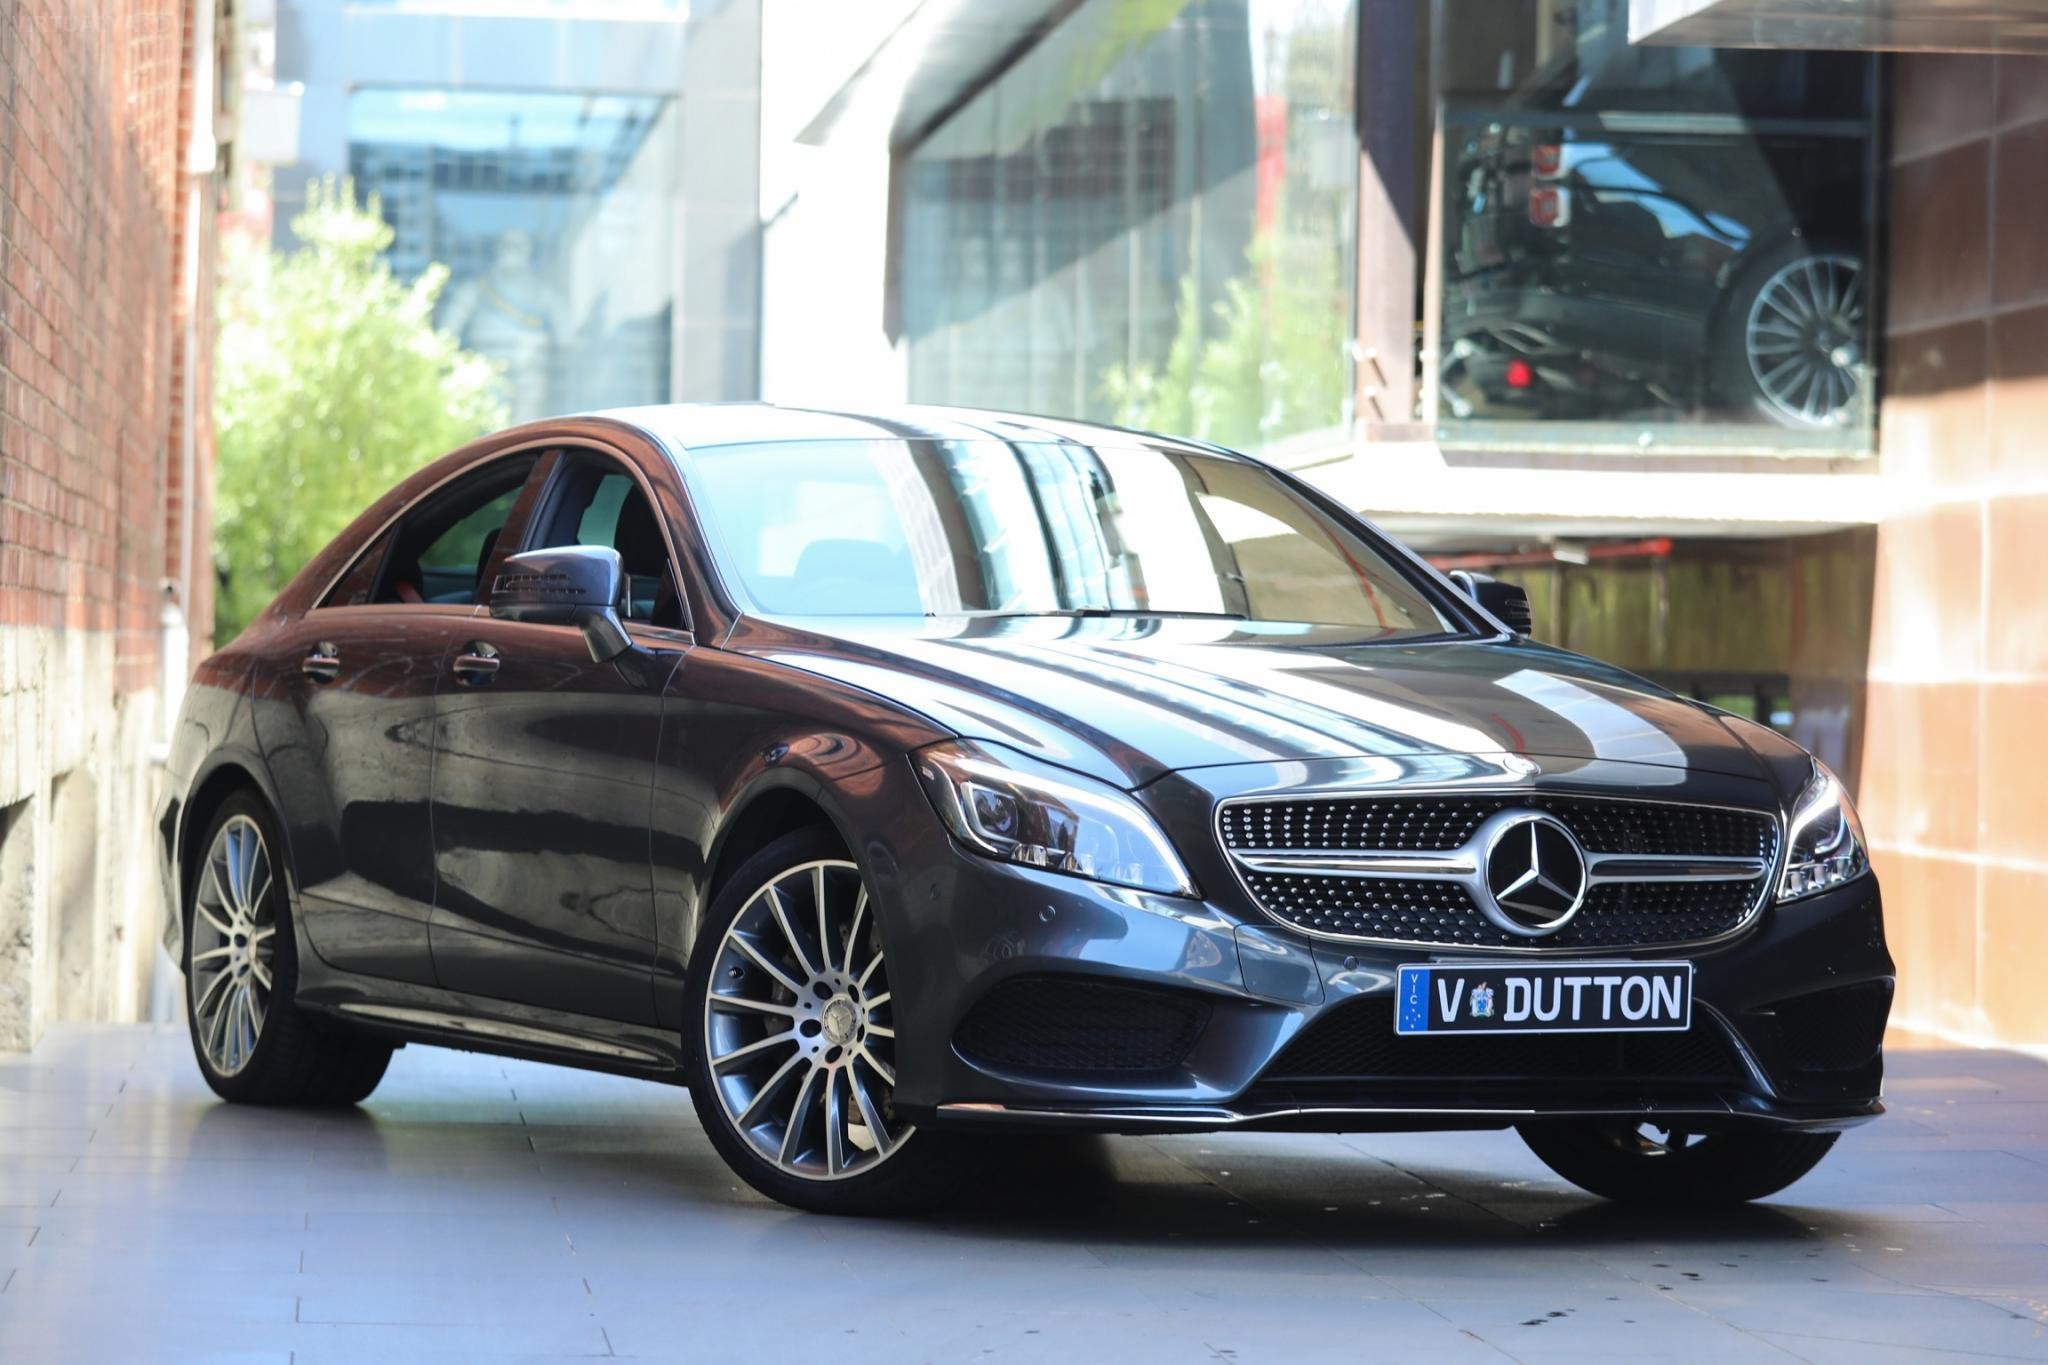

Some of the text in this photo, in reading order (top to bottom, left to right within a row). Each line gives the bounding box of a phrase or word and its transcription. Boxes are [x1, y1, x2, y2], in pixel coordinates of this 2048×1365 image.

[1410, 974, 1418, 1005] VIC
[1437, 976, 1682, 1022] V DUTTON
